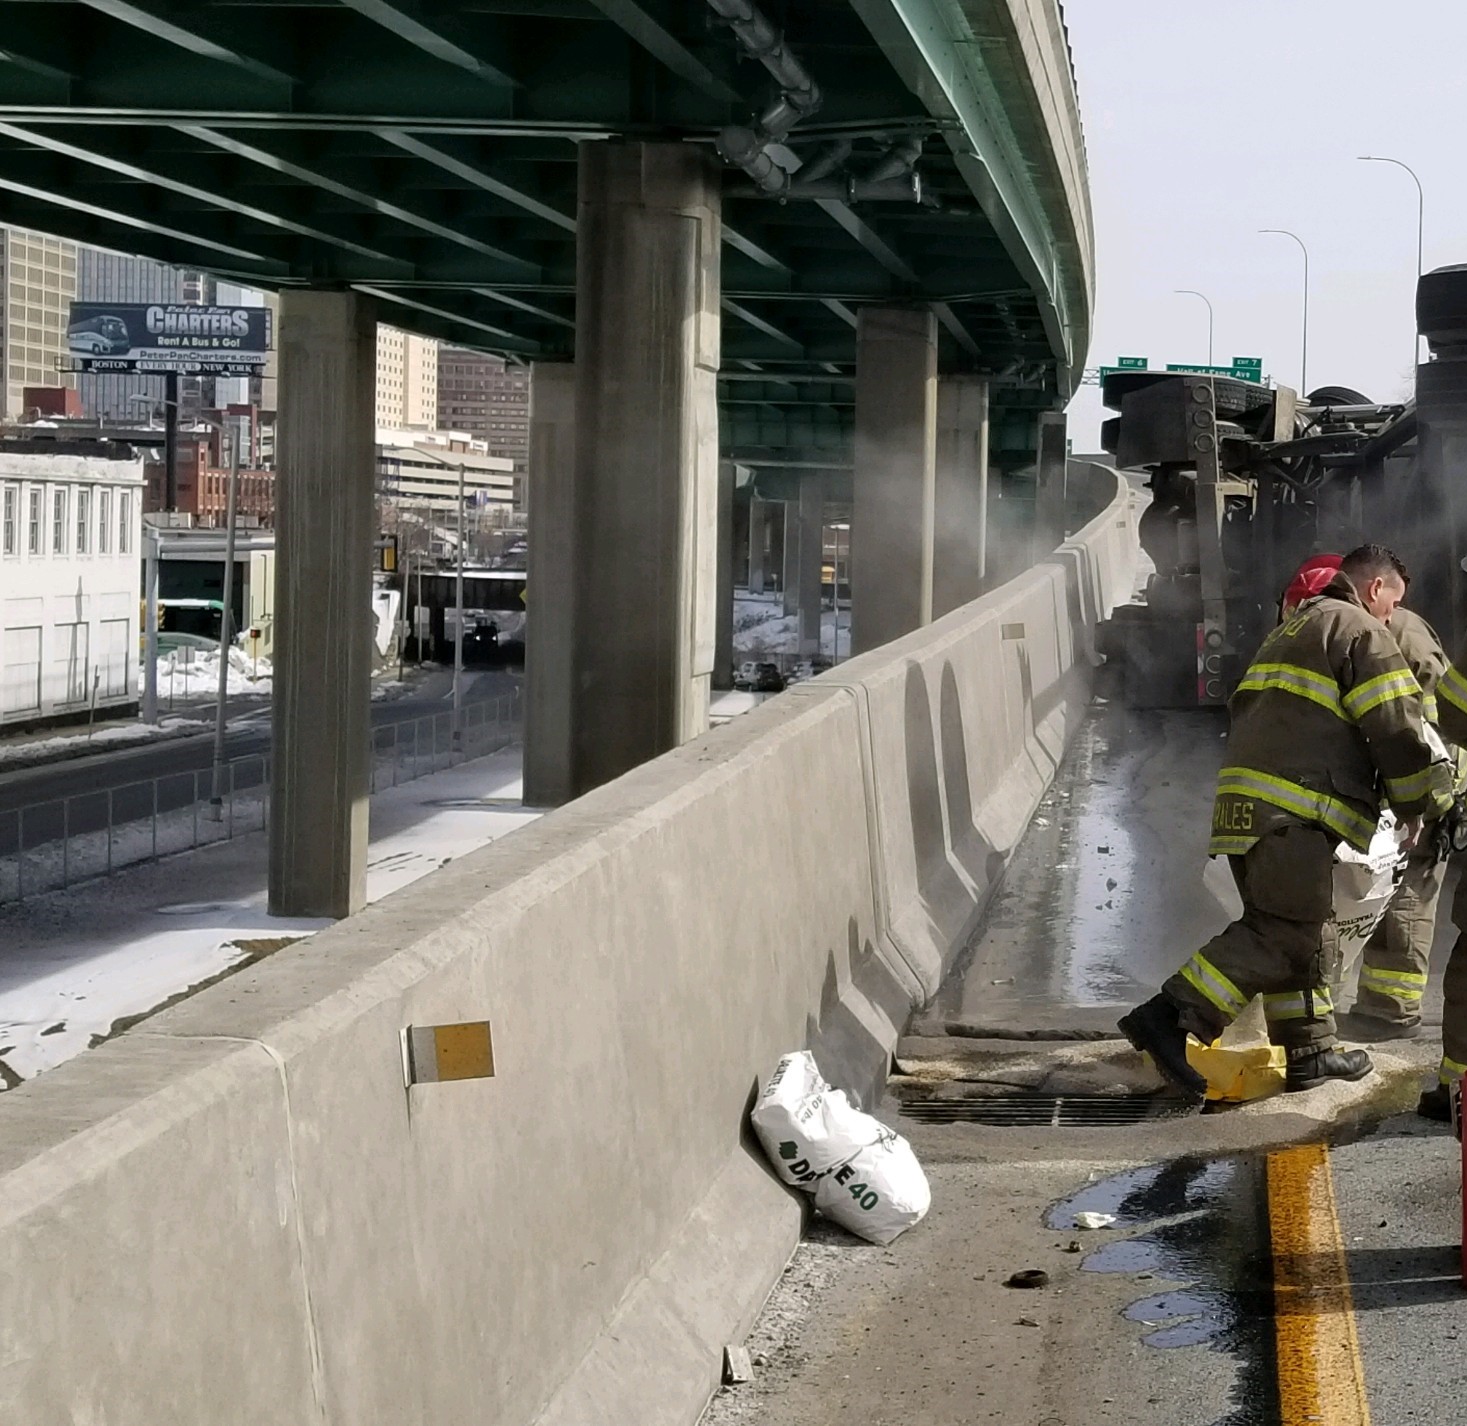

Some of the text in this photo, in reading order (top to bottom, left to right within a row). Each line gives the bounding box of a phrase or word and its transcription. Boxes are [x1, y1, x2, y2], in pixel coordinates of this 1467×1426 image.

[146, 306, 249, 337] CHARTERS
[157, 336, 240, 347] Rent A Bus & Go!
[140, 351, 262, 362] PeterPanCharters.com
[92, 360, 253, 372] BOSTON EVERY HOUR NEW YORK
[848, 1182, 879, 1211] 40
